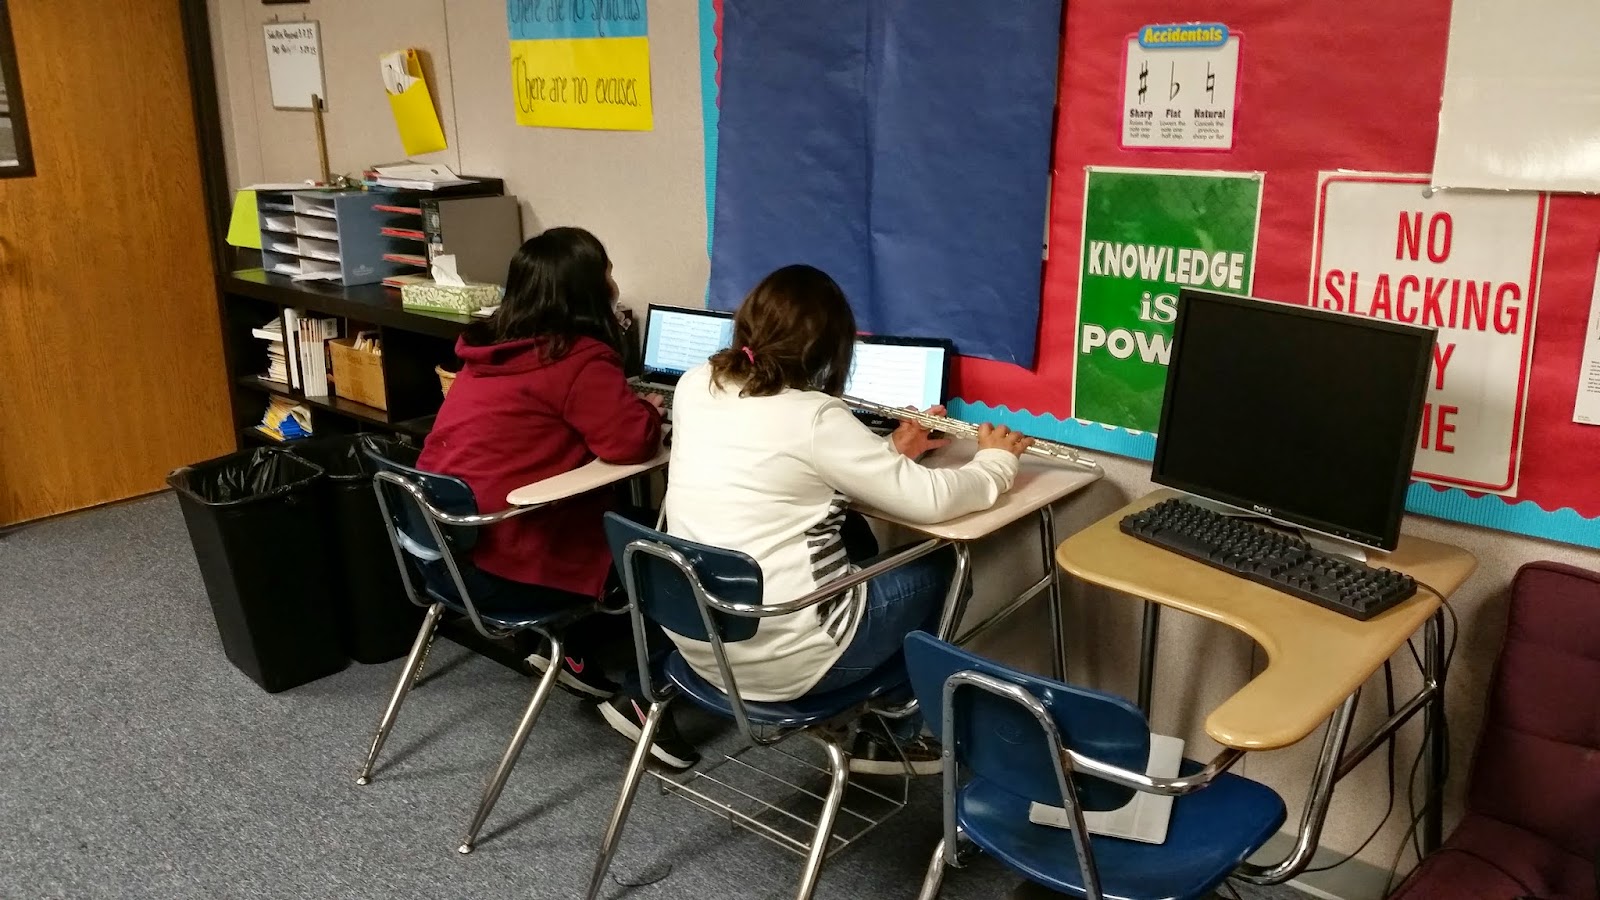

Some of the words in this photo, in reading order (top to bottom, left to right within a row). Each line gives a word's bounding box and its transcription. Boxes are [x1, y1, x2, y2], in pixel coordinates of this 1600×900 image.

[1144, 28, 1223, 43] Accidentals
[511, 55, 545, 113] There
[549, 76, 568, 103] are
[573, 76, 588, 104] no
[595, 77, 642, 107] excuses.
[1130, 109, 1153, 119] Sharp
[1166, 109, 1182, 118] Flat
[1194, 109, 1226, 119] Natural
[1395, 210, 1452, 263] NO
[1088, 240, 1245, 289] KNOWLEDGE
[1323, 268, 1521, 334] SLACKING
[1082, 323, 1174, 365] POW
[1253, 504, 1273, 516] DELL
